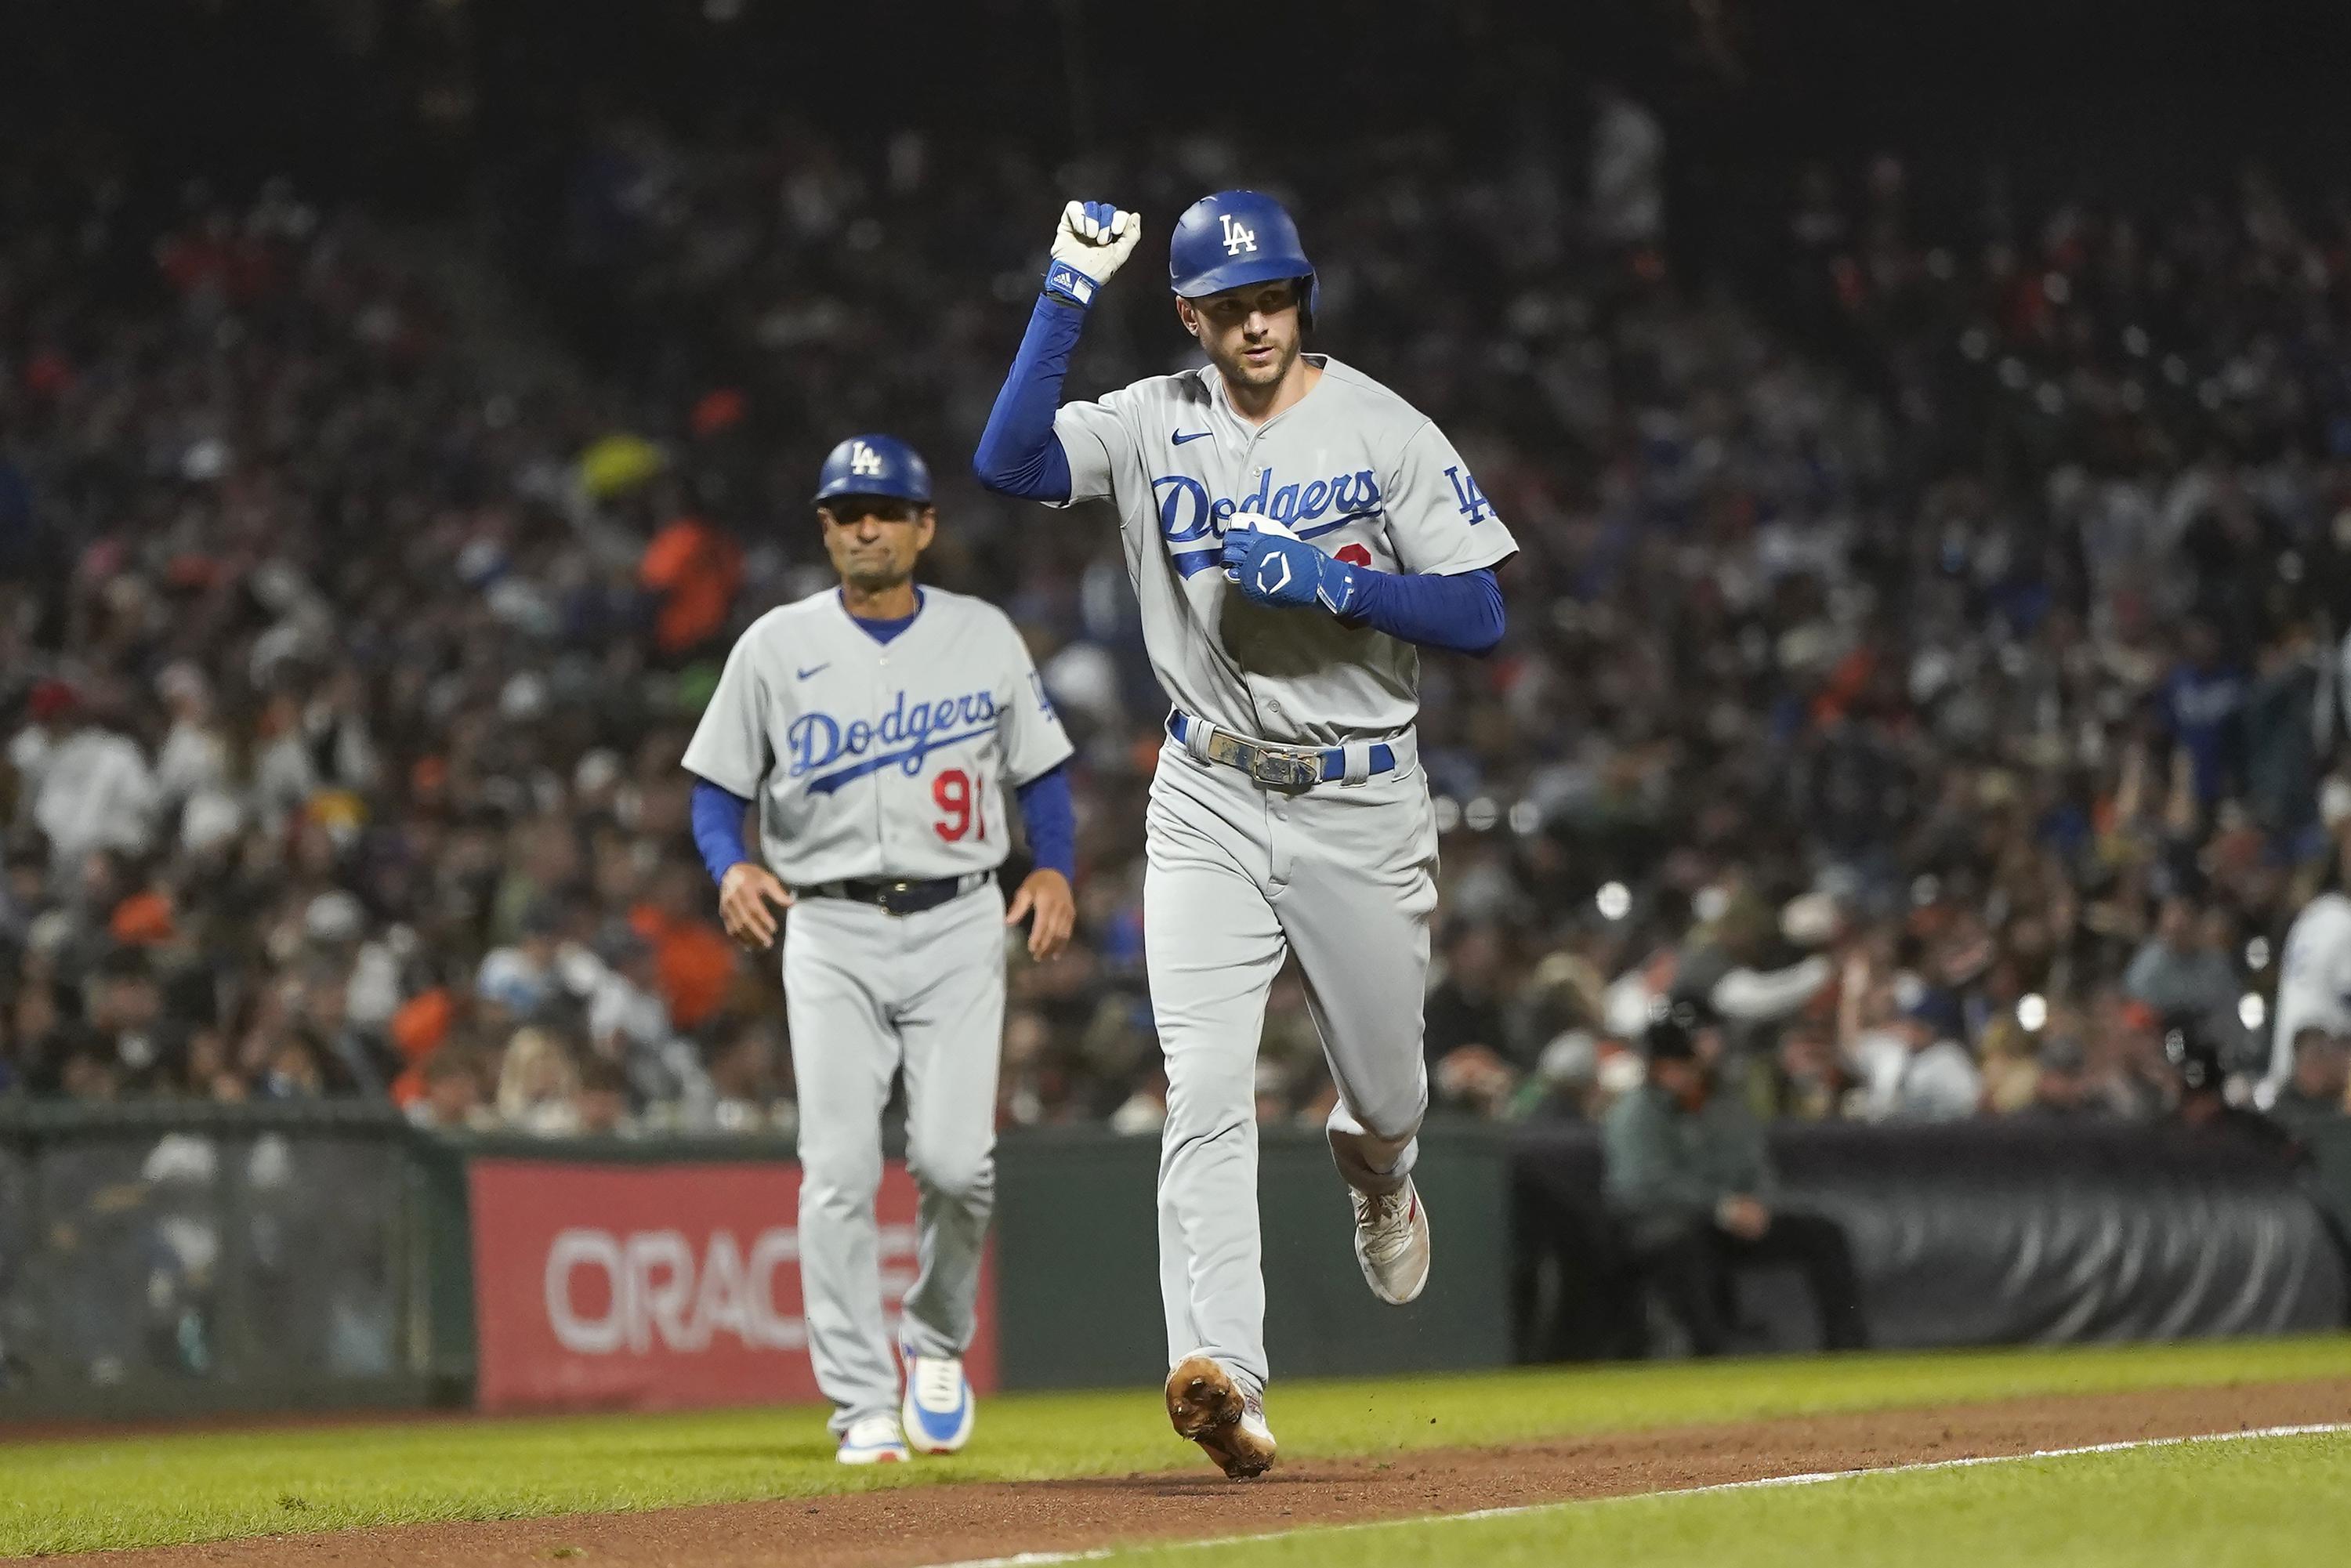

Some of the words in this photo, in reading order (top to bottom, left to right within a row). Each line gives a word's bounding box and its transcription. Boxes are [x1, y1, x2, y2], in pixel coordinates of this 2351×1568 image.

[1219, 214, 1257, 255] LA
[850, 440, 882, 476] LA
[1152, 467, 1382, 542] Dodgers
[1443, 465, 1496, 526] LA
[788, 690, 997, 777] Dodgers
[545, 1225, 922, 1356] ORAC
